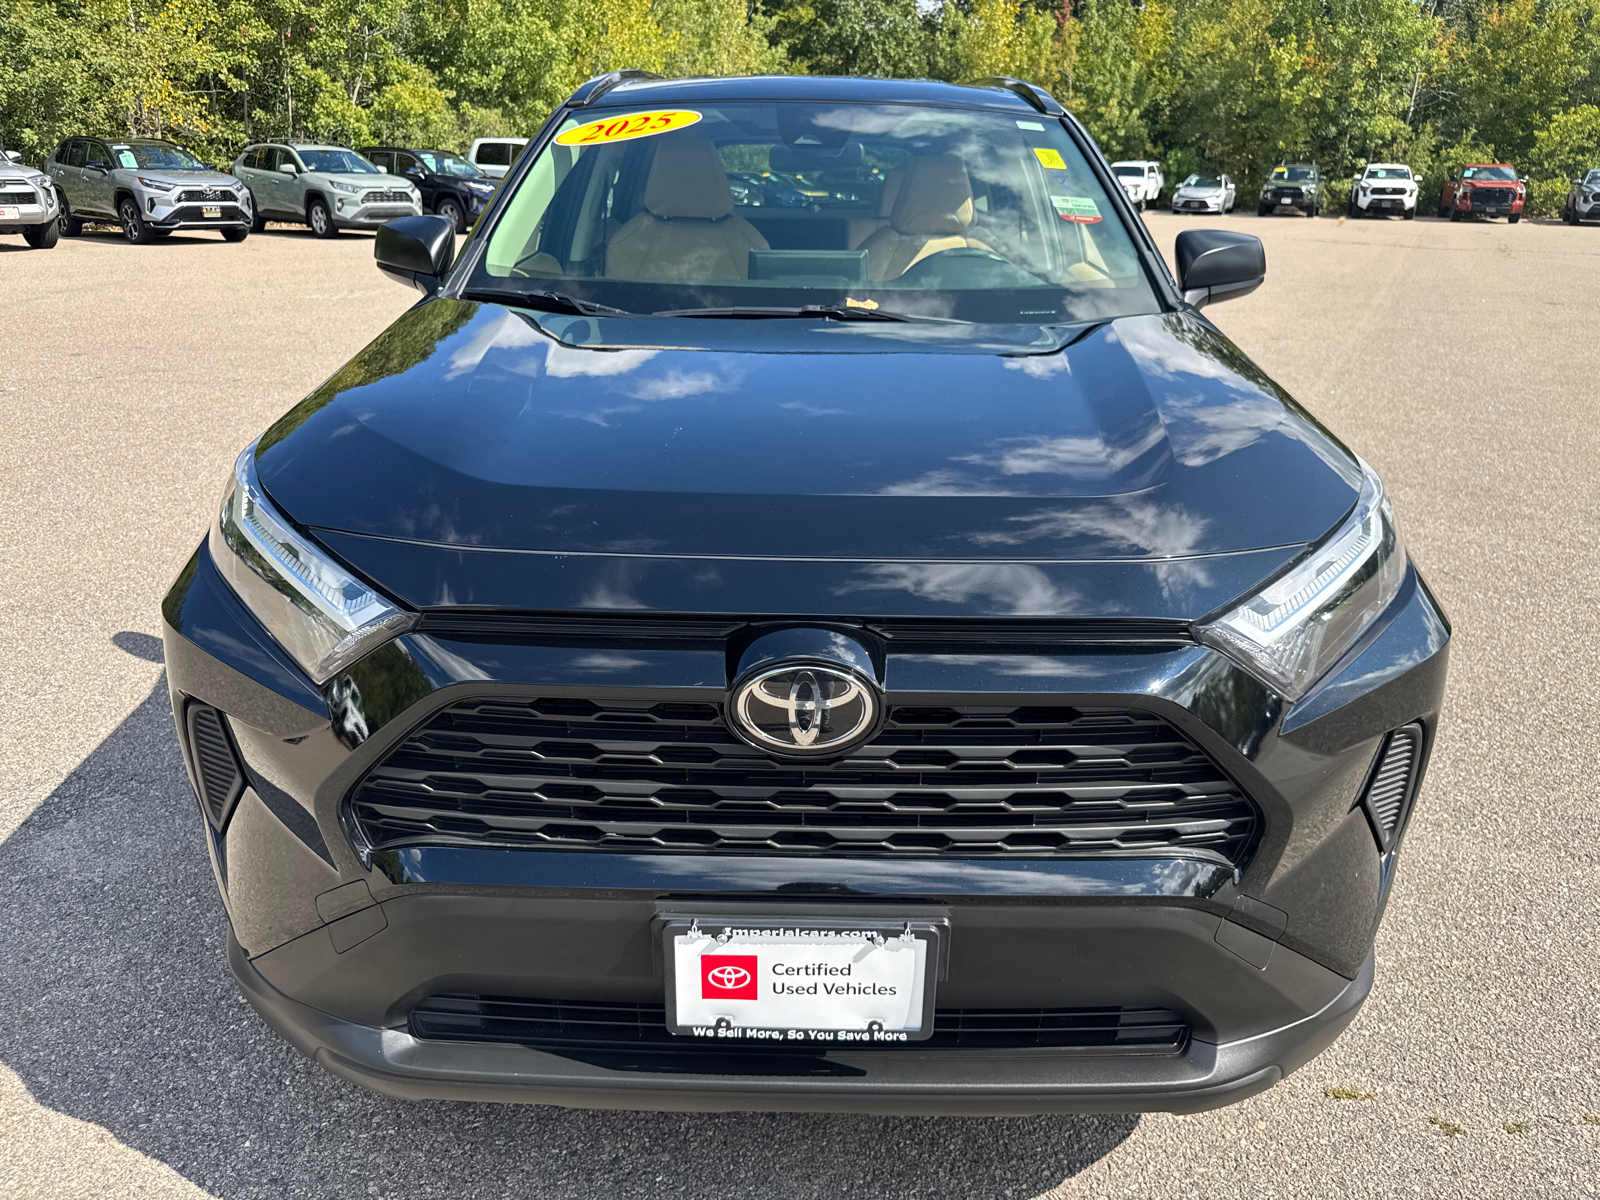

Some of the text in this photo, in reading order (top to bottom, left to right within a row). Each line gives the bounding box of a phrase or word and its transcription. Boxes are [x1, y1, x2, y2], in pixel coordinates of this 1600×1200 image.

[578, 113, 677, 142] 2025
[724, 927, 878, 938] Imperialcars.com
[772, 963, 852, 976] Certified
[772, 982, 897, 996] Used Vehicles
[692, 1027, 908, 1041] We Sell More, So You Save More
